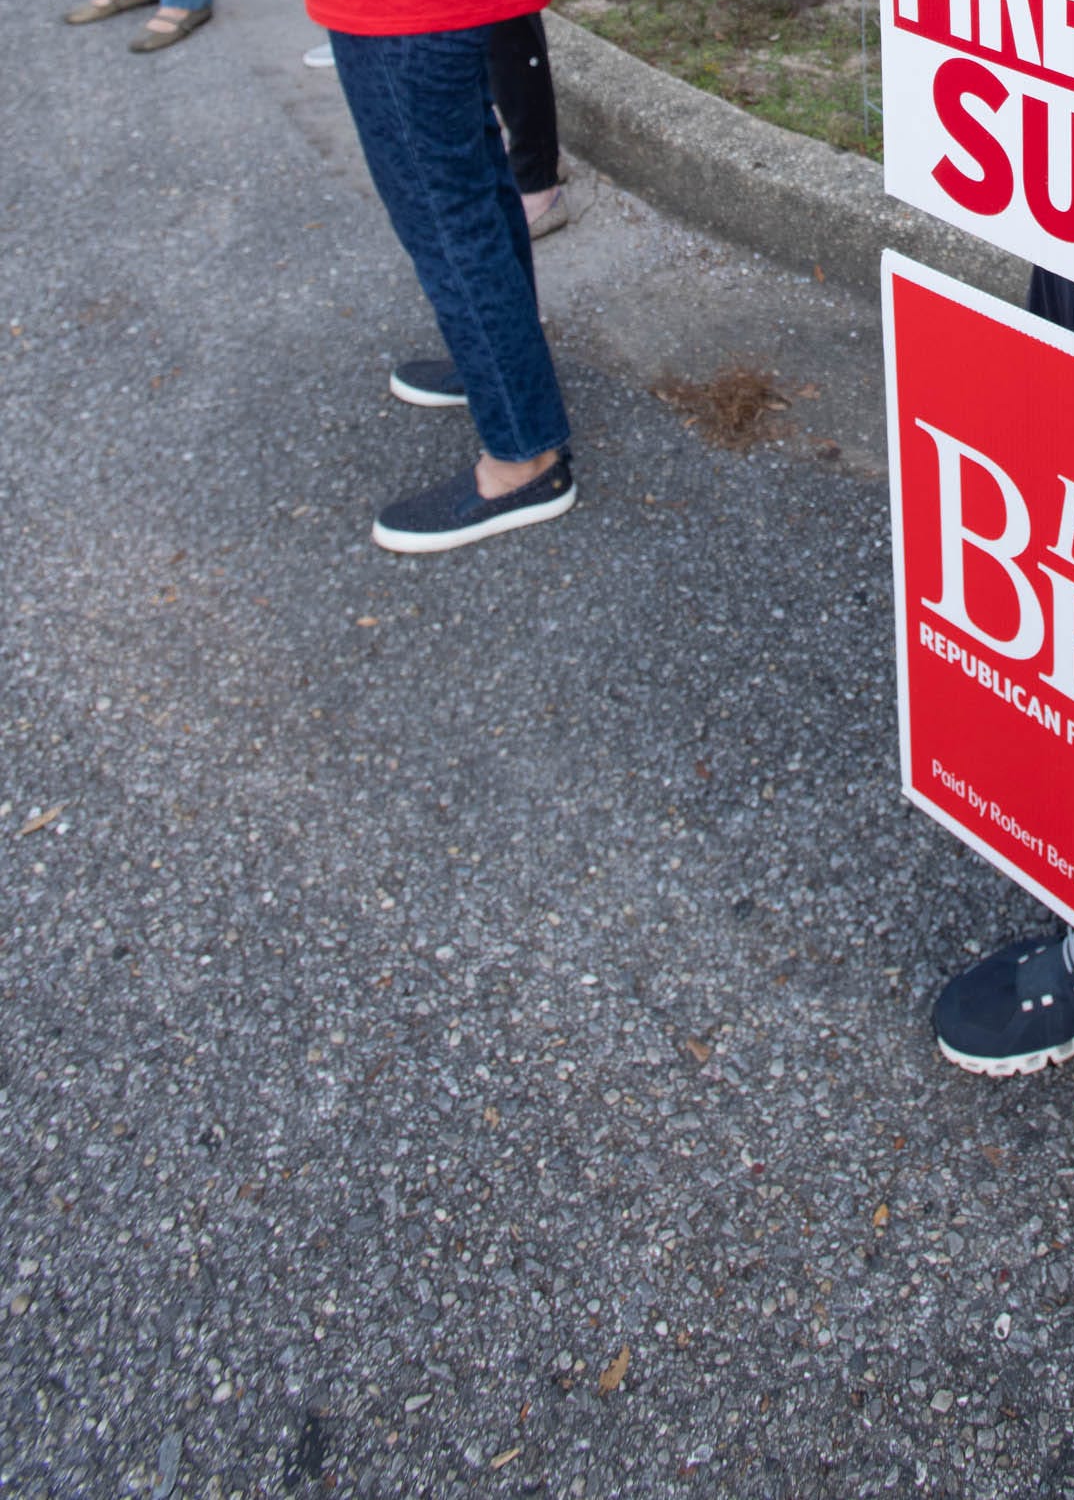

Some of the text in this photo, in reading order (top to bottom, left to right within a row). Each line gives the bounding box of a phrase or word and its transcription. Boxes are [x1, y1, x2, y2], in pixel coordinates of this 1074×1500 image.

[919, 621, 1061, 737] REPUBLICAN
[932, 759, 966, 799] Paid
[968, 786, 988, 817] by
[990, 801, 1044, 857] Robert
